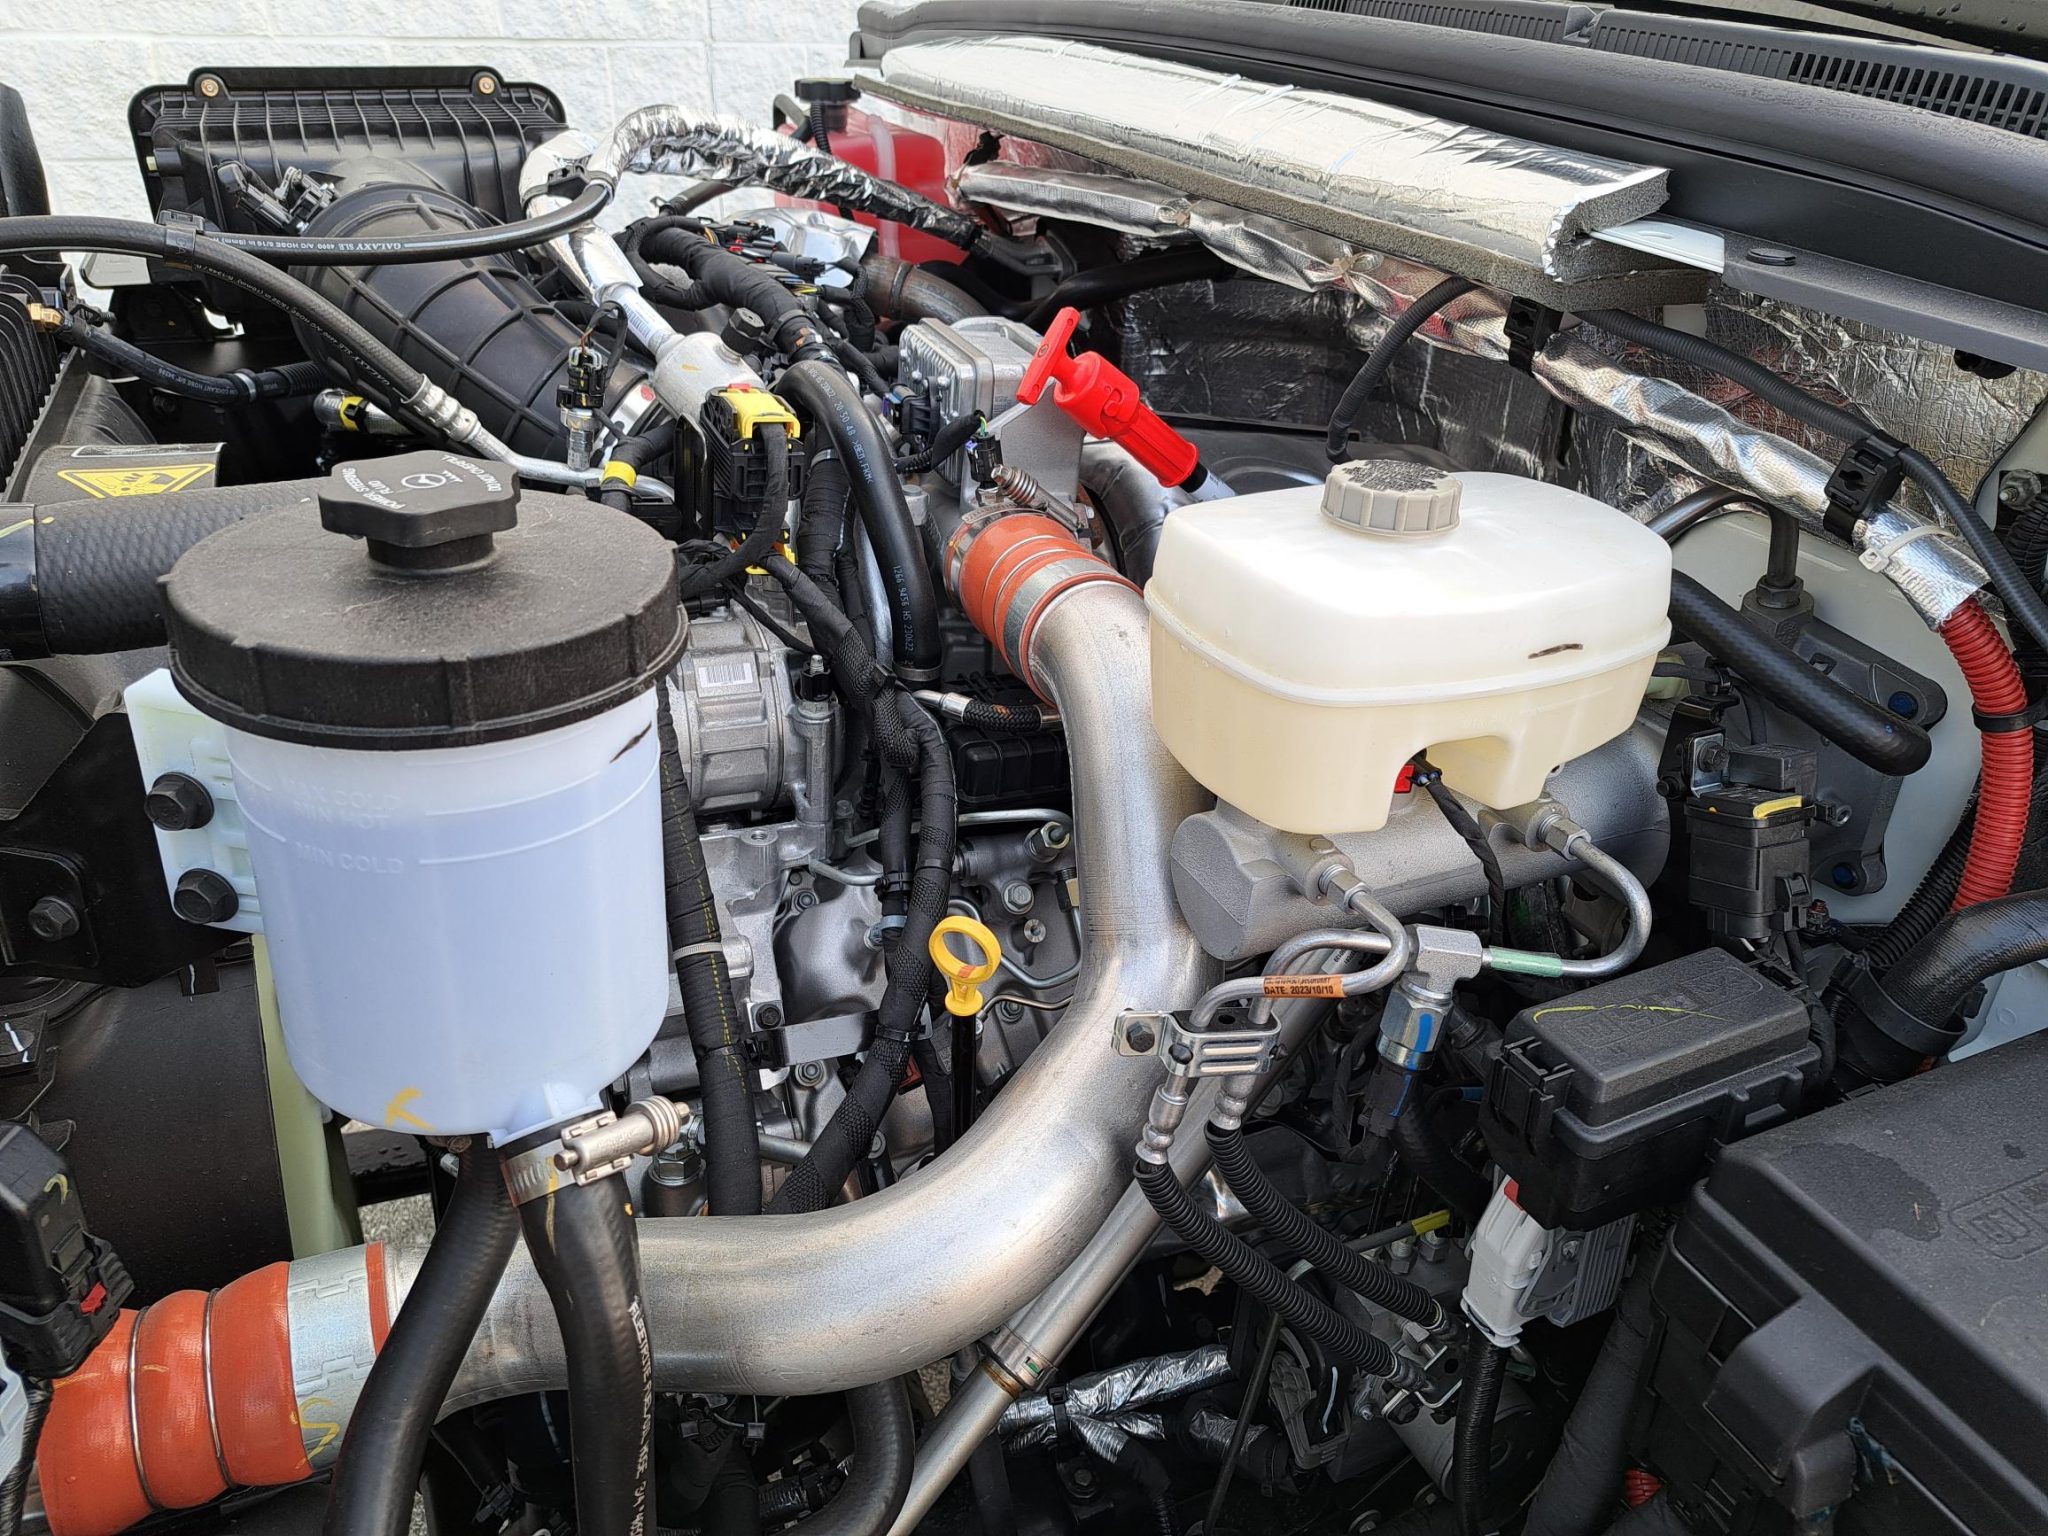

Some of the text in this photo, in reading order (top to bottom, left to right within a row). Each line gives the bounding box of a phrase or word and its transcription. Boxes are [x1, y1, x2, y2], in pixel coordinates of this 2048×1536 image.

[339, 242, 354, 250] SLE
[356, 242, 401, 250] GALAXY
[342, 467, 406, 510] POWER STEERING
[368, 480, 394, 495] FLUID
[341, 852, 403, 874] COLD
[1290, 985, 1334, 995] 2023/10/10
